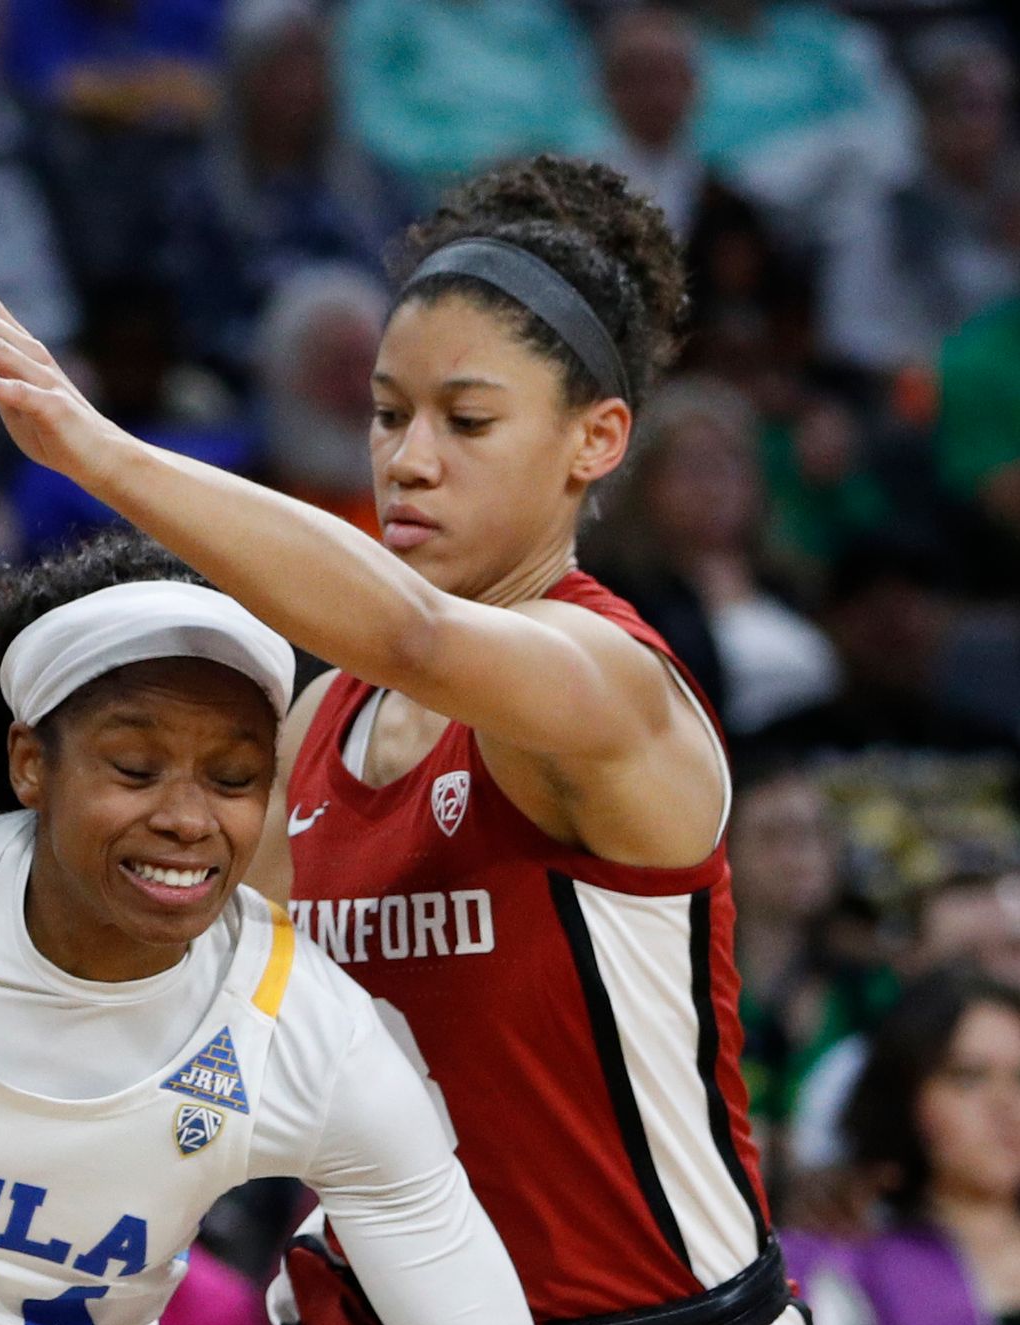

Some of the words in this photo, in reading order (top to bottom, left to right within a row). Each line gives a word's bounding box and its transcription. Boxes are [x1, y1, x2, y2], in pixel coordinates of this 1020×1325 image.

[288, 889, 495, 964] ANFORD
[181, 1066, 239, 1097] JRW
[177, 1105, 222, 1141] PAC
[179, 1127, 205, 1149] 12
